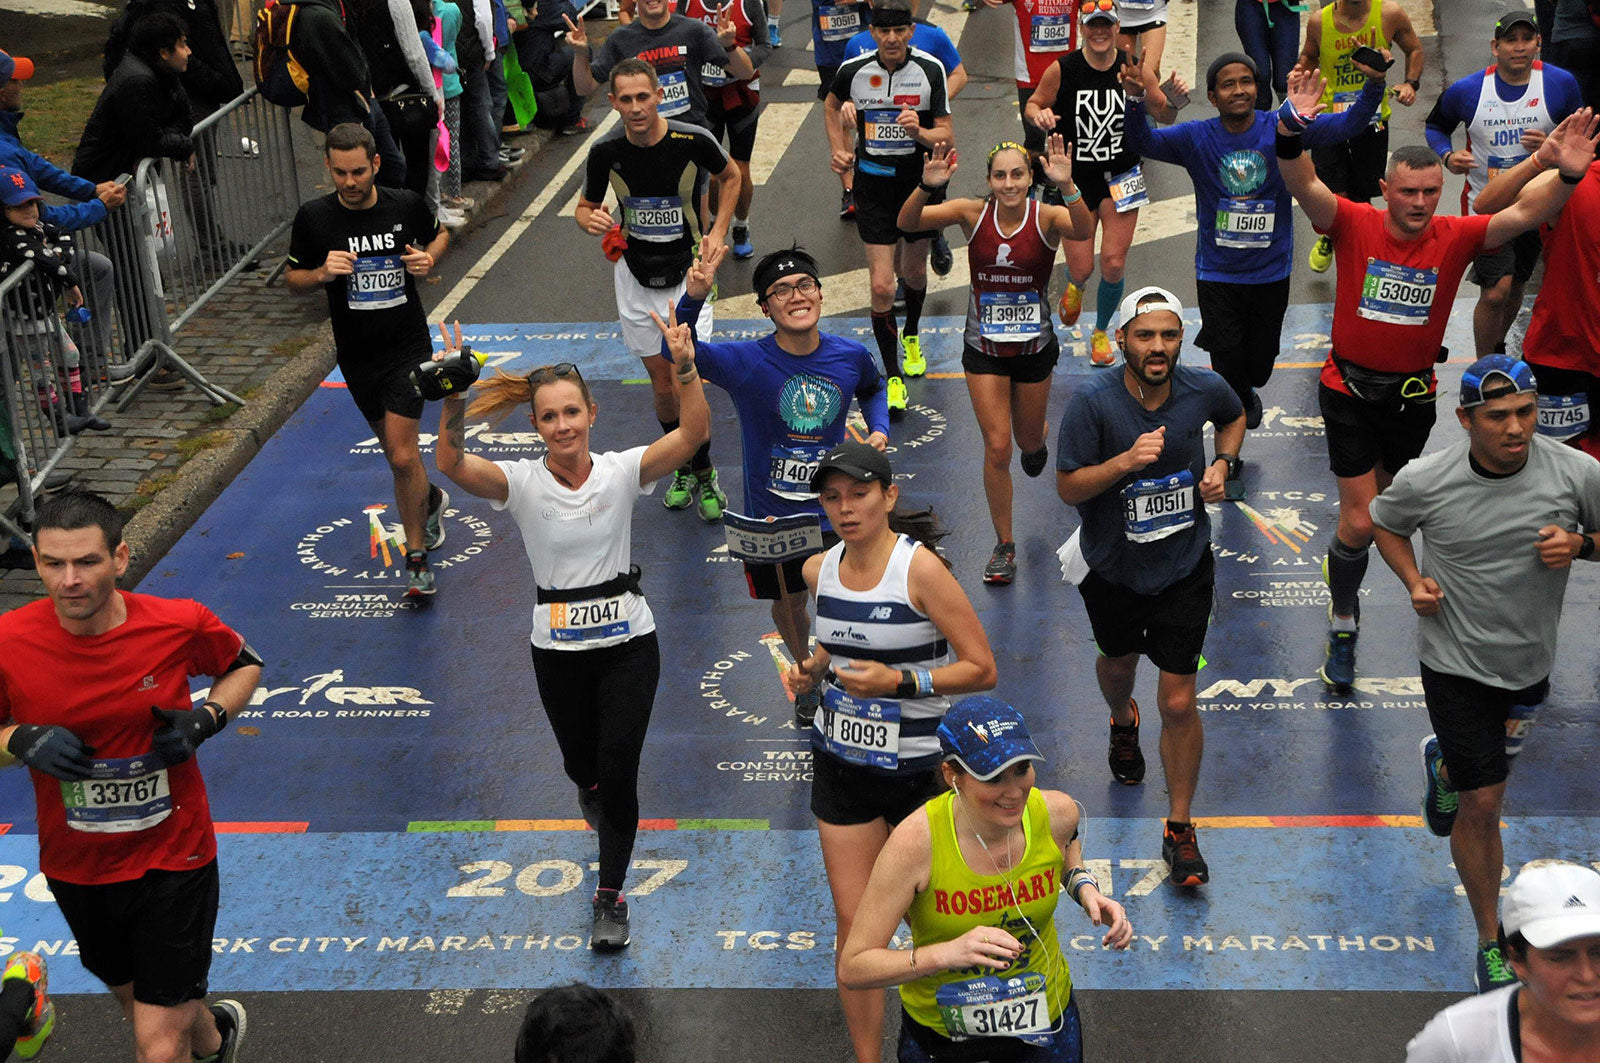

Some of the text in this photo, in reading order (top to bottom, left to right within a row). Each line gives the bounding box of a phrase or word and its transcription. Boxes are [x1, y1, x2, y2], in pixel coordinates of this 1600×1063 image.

[830, 14, 857, 28] 30519
[1043, 25, 1066, 39] 9843
[637, 45, 679, 62] SWIM
[1075, 89, 1126, 117] RUN
[1483, 117, 1539, 127] TEAM ULTRA
[638, 209, 679, 226] 32680
[1236, 216, 1267, 231] 15119
[348, 232, 396, 253] HANS
[361, 271, 402, 290] 37025
[978, 272, 1033, 284] ST. JUDE HERO
[1380, 281, 1432, 305] 53090
[997, 306, 1035, 322] 39132
[461, 334, 518, 343] NEW
[523, 332, 588, 341] YORK
[1539, 408, 1584, 426] 37745
[777, 460, 784, 469] 3
[1261, 491, 1327, 502] TCS
[1127, 499, 1134, 510] 3
[1144, 491, 1186, 517] 40511
[432, 514, 493, 570] NEW YORK
[729, 528, 816, 543] PACE PER MILE
[296, 517, 353, 577] MARATHON
[739, 536, 808, 555] 9:09
[334, 594, 389, 602] TATA
[289, 602, 421, 611] CONSULTANCY
[557, 605, 563, 615] 2
[570, 600, 620, 626] 27047
[868, 606, 892, 620] NB
[308, 610, 395, 619] SERVICES
[557, 617, 564, 628] C
[700, 650, 768, 726] MARATHON
[1196, 703, 1242, 711] NEW
[1248, 702, 1307, 710] YORK
[1313, 701, 1374, 710] ROAD
[271, 709, 320, 718] ROAD
[325, 709, 432, 718] RUNNERS
[867, 711, 882, 719] TATA
[840, 718, 888, 748] 8093
[72, 781, 80, 793] 2
[91, 774, 160, 805] 33767
[74, 795, 83, 806] C
[934, 867, 1055, 916] ROSEMARY
[268, 936, 367, 953] CITY
[714, 929, 817, 951] TCS
[1181, 934, 1436, 952] MARATHON
[957, 985, 1000, 998] CONSULTANCY
[967, 981, 987, 990] TATA
[1008, 985, 1026, 995] TATA
[966, 993, 994, 1003] SERVICES
[950, 1008, 960, 1021] 2
[973, 998, 1039, 1034] 31427
